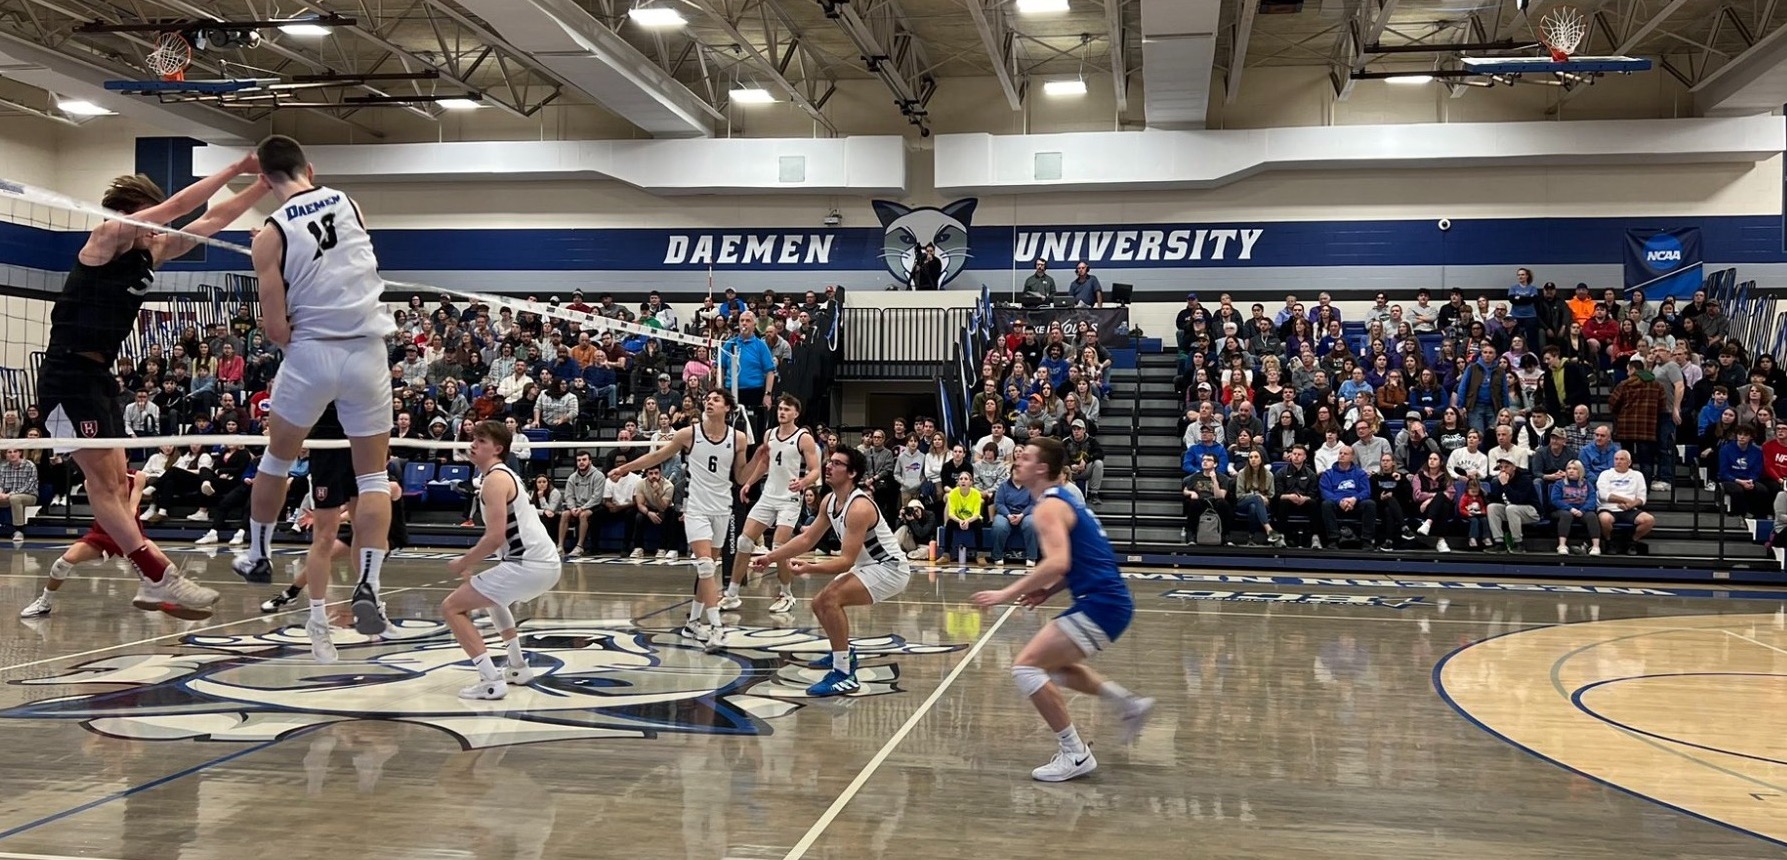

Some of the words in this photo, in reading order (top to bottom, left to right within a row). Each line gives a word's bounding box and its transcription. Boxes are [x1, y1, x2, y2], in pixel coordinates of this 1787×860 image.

[285, 195, 341, 221] DAEMEN
[663, 235, 834, 264] DAEMEN
[1014, 229, 1264, 262] UNIVERSITY
[1647, 250, 1681, 261] NCAA
[1061, 318, 1099, 334] YOUS
[708, 456, 718, 473] 6
[775, 451, 782, 466] 4
[1120, 573, 1277, 584] NEW
[1300, 578, 1677, 596] WESTERN
